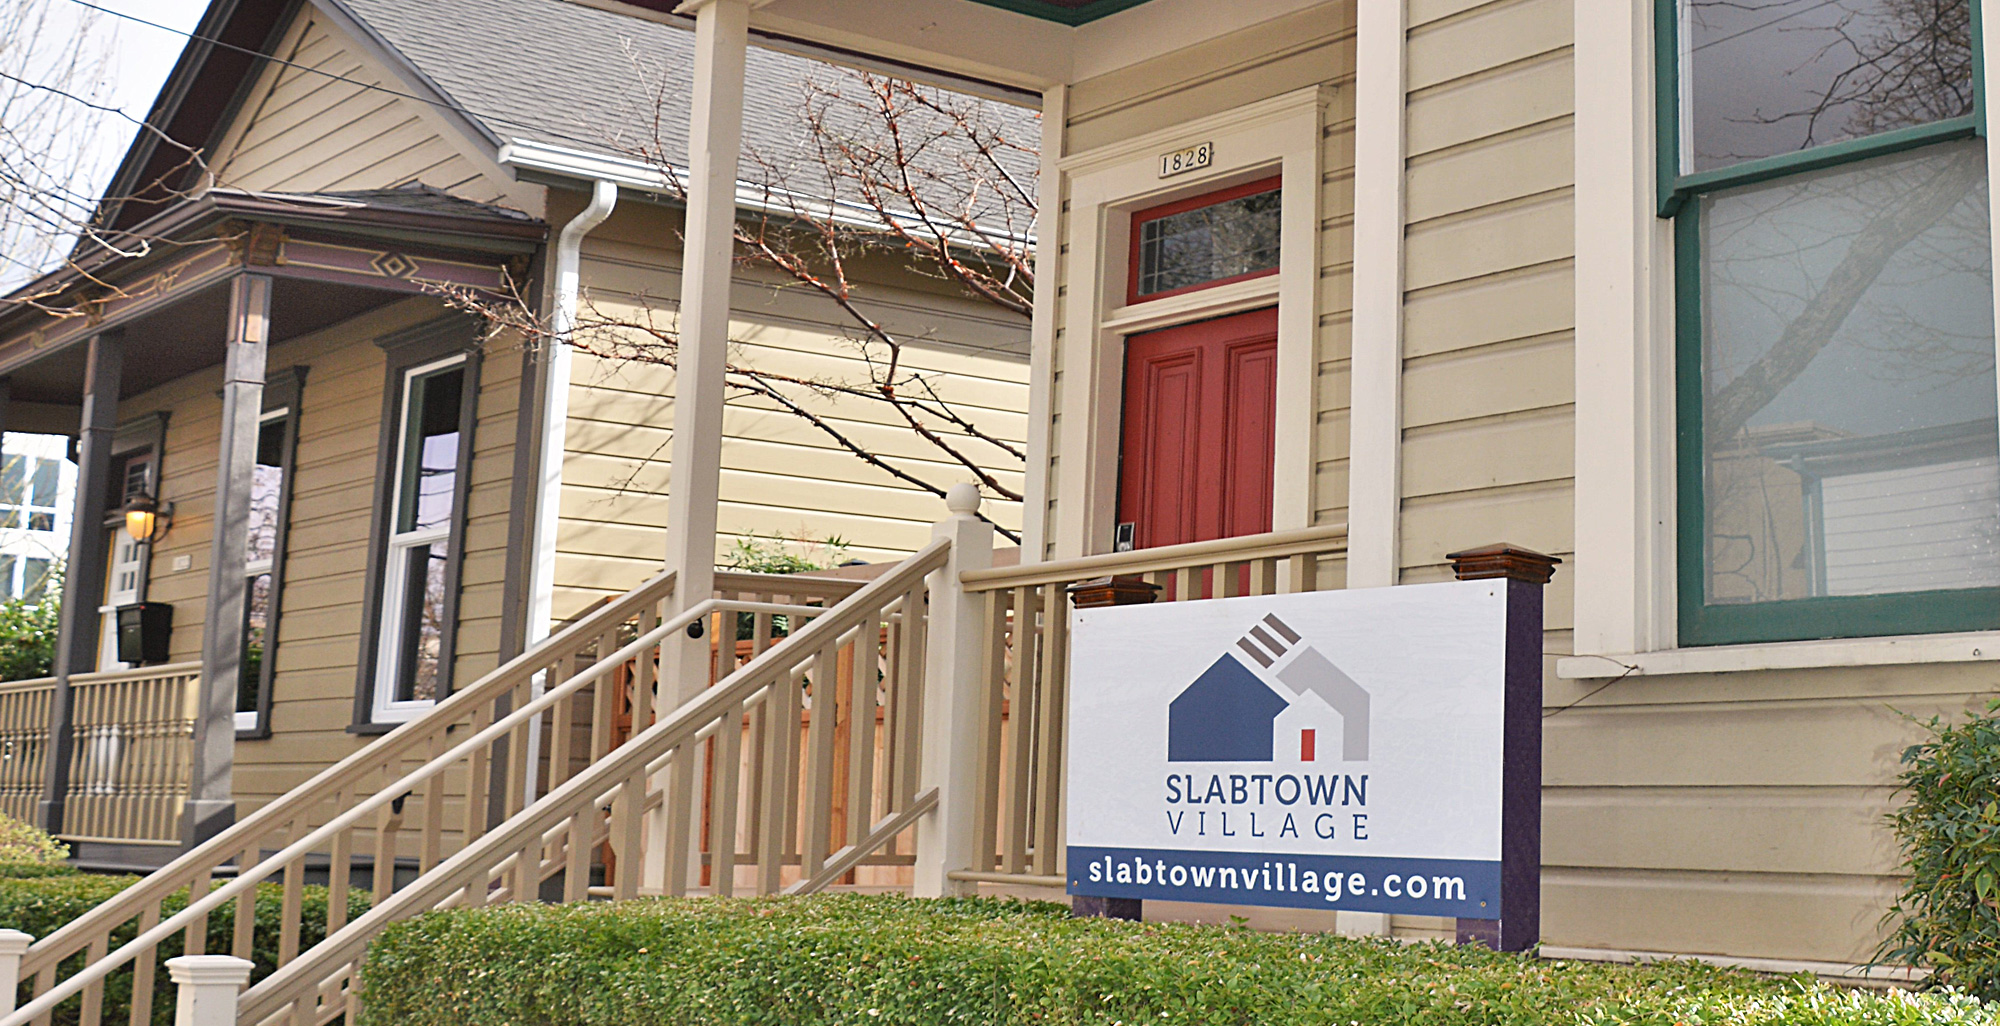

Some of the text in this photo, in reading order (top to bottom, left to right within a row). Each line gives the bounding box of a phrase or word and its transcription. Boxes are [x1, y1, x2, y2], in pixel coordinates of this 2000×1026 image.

[1163, 147, 1207, 173] 1828
[1166, 774, 1369, 806] SLABTOWN
[1167, 811, 1369, 840] VILLAGE
[1088, 856, 1467, 902] slabtownvillage.com
